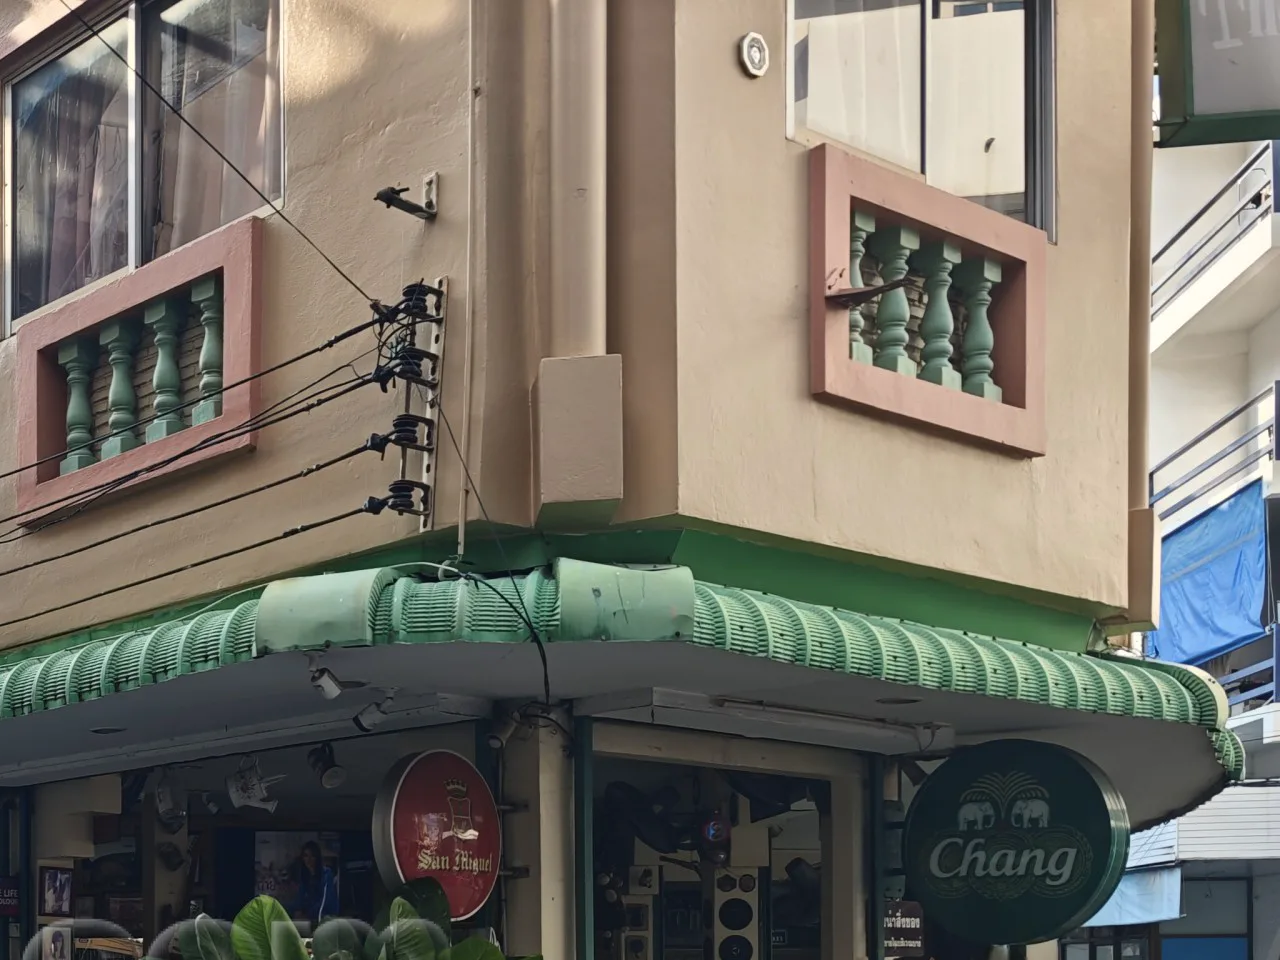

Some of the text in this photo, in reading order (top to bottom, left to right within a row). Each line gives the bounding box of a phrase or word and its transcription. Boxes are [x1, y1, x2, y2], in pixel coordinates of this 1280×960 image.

[417, 848, 493, 875] San Miguel
[929, 837, 1077, 886] Chang
[3, 888, 19, 898] LIFE
